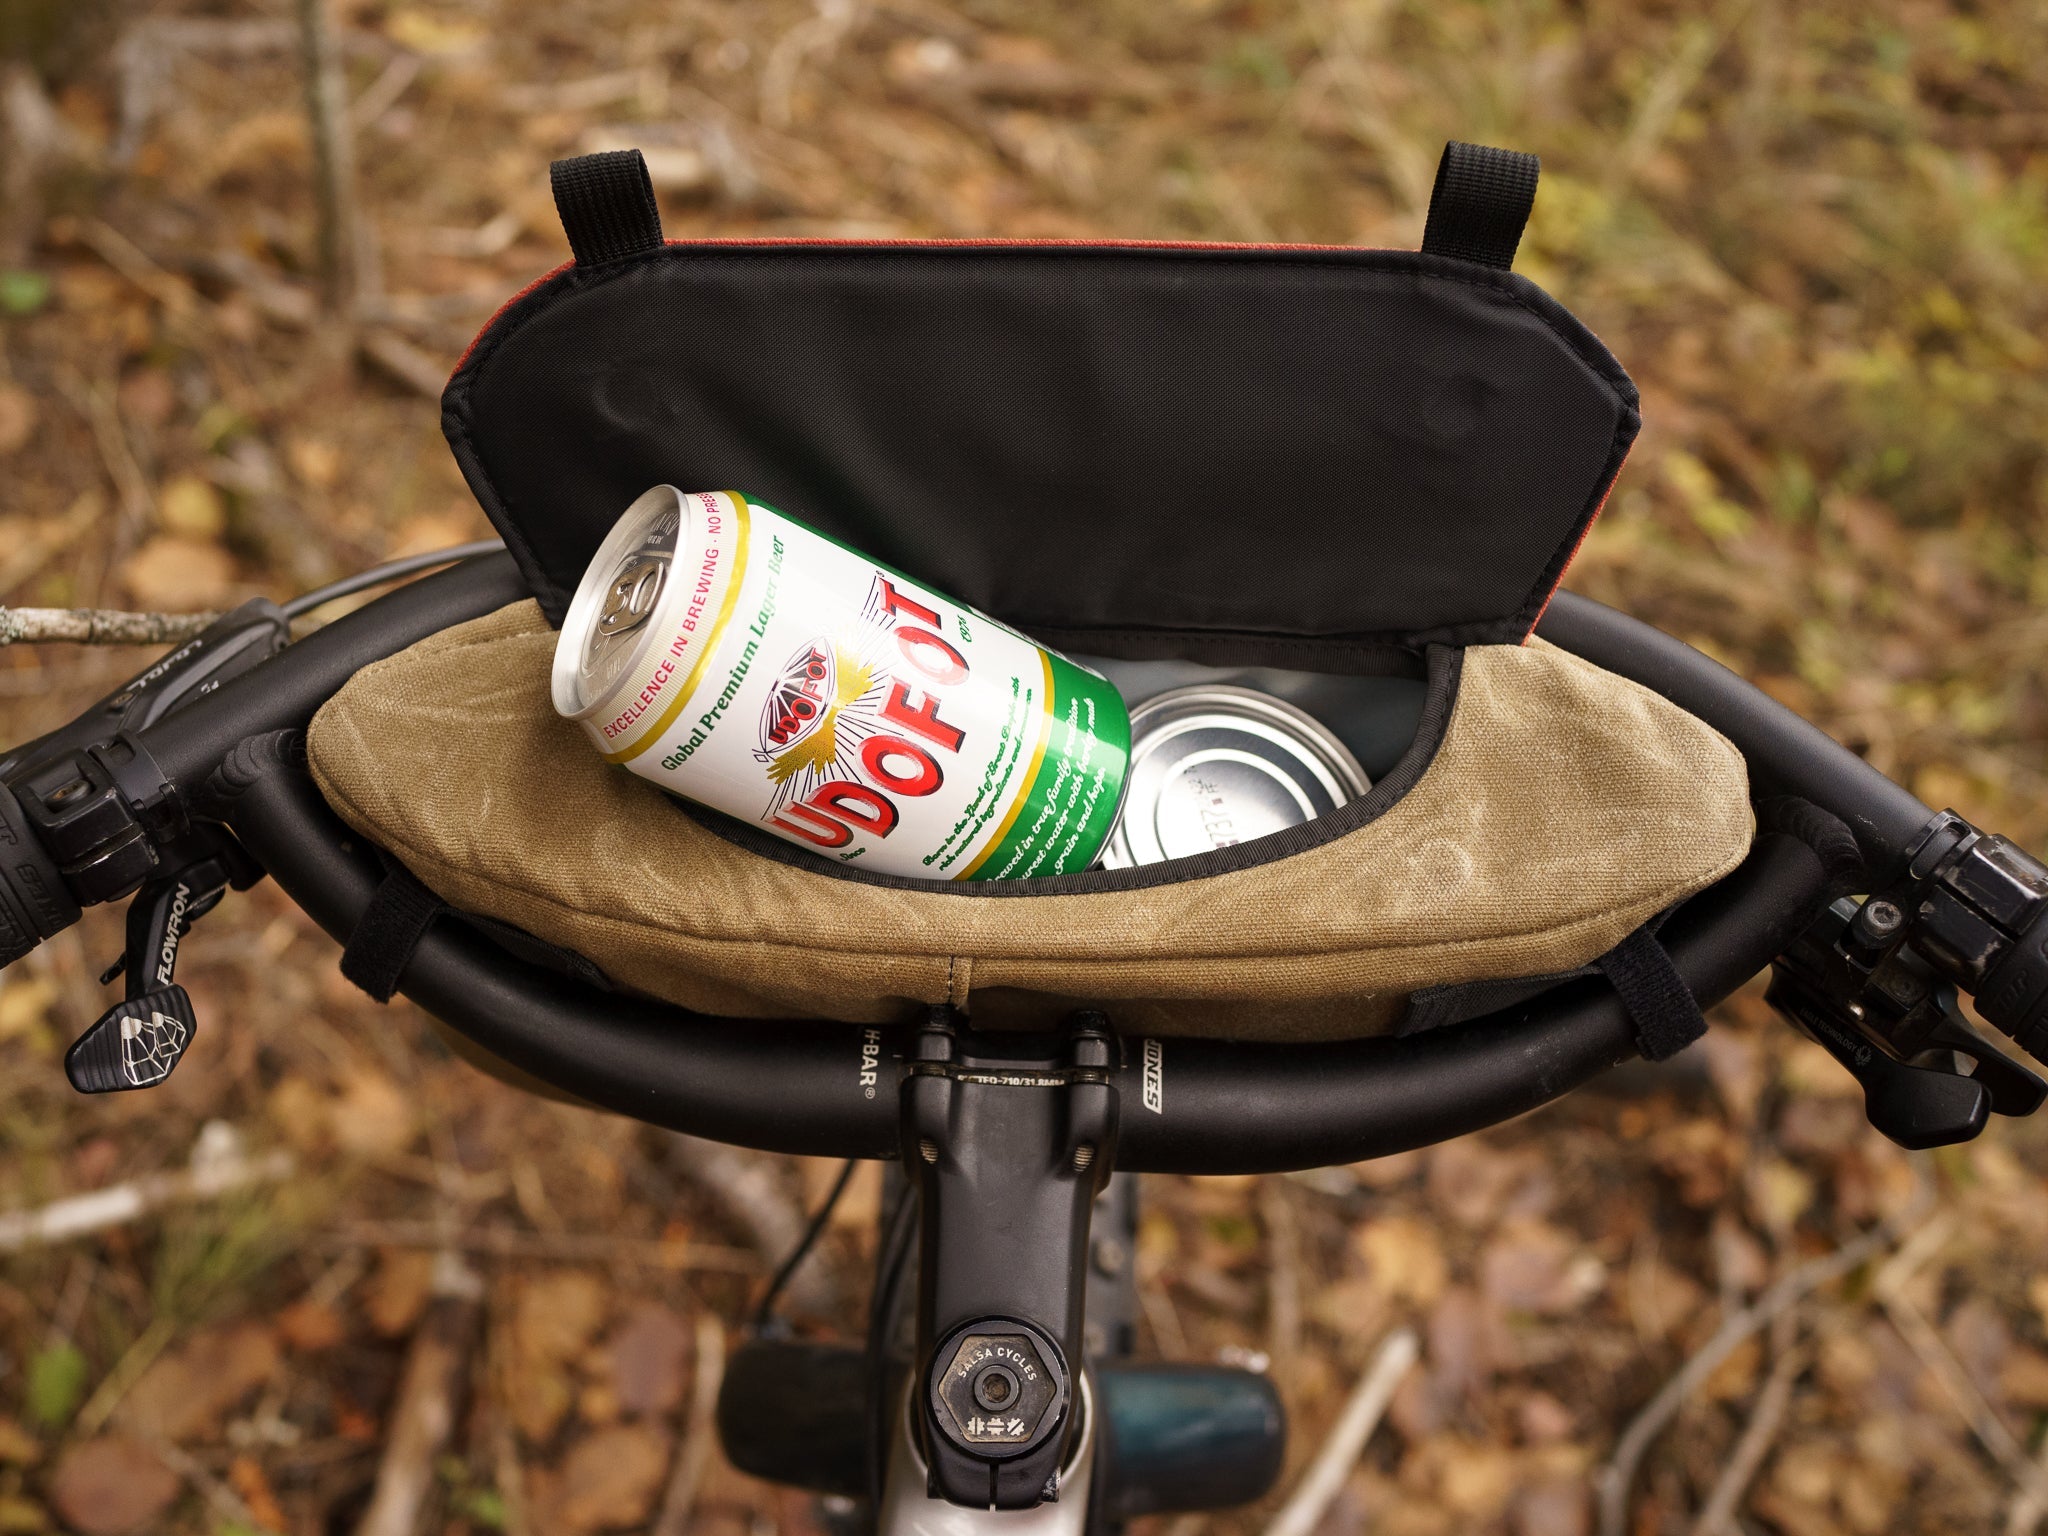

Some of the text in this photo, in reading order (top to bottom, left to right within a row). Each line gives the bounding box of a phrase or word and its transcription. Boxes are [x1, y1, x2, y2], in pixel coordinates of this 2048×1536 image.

[603, 659, 675, 739] EXCELLENCE
[670, 635, 689, 657] IN
[682, 548, 720, 632] BREWING
[708, 516, 721, 534] NO
[661, 535, 785, 771] Global Premium Lager Beer
[768, 646, 827, 744] UDOFOT
[764, 577, 970, 848] UDOFOT
[986, 697, 1079, 881] rewed in true family tradition
[1016, 698, 1097, 881] urest water with barley malt
[1055, 833, 1079, 875] grain
[1076, 799, 1092, 833] and
[156, 883, 190, 984] FLOWTRON
[1145, 1039, 1160, 1111] JONES
[958, 1347, 1037, 1381] SALSA CYCLES
